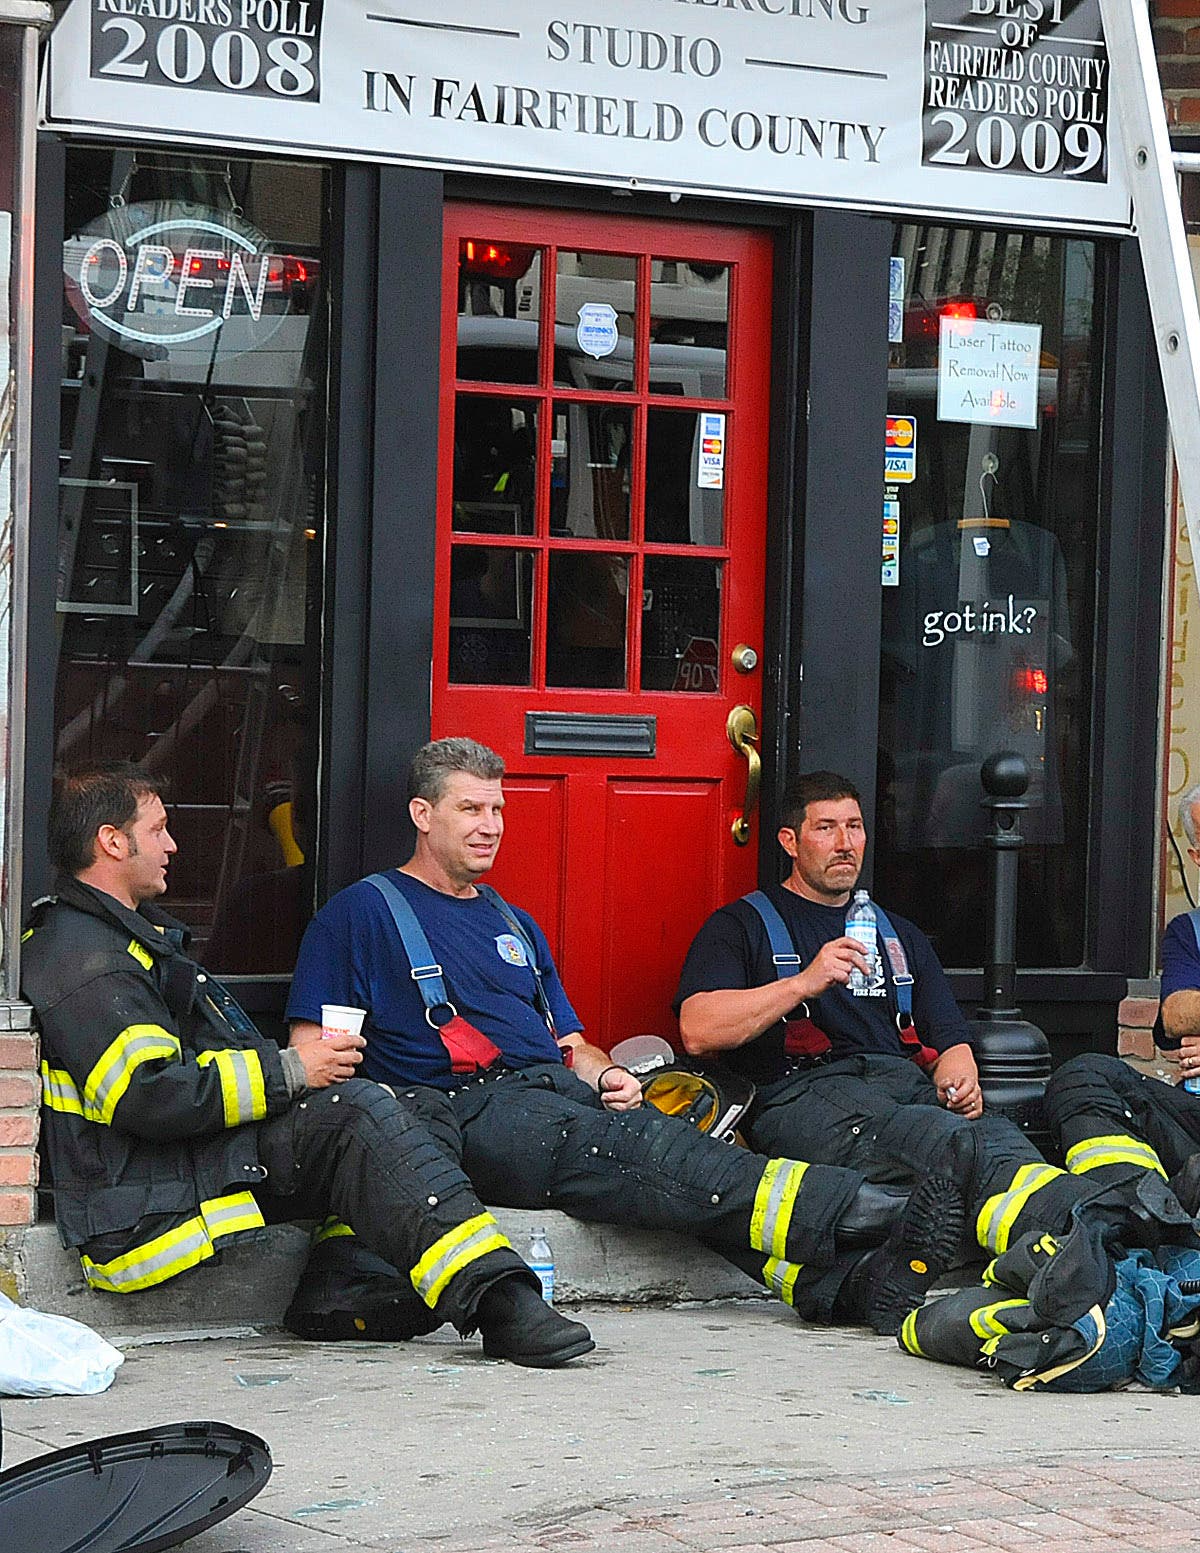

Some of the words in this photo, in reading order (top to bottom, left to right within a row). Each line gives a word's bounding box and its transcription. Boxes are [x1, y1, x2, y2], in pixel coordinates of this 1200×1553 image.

[240, 0, 316, 37] POLL
[1001, 21, 1038, 48] OF
[99, 17, 316, 96] 2008
[547, 20, 721, 77] STUDIO
[929, 40, 1024, 82] FAIRFIELD
[1029, 52, 1106, 90] COUNTY
[361, 70, 416, 116] IN
[429, 78, 684, 143] FAIRFIELD
[698, 108, 887, 163] COUNTY
[928, 75, 1039, 118] READERS
[1044, 87, 1104, 124] POLL
[929, 111, 1102, 175] 2009
[80, 238, 268, 322] OPEN
[949, 329, 985, 350] Laser
[988, 332, 1032, 353] Tattoo
[949, 359, 1000, 379] Removal
[1001, 364, 1031, 382] Now
[703, 457, 721, 466] VISA
[922, 605, 976, 646] got
[982, 594, 1037, 634] ink?
